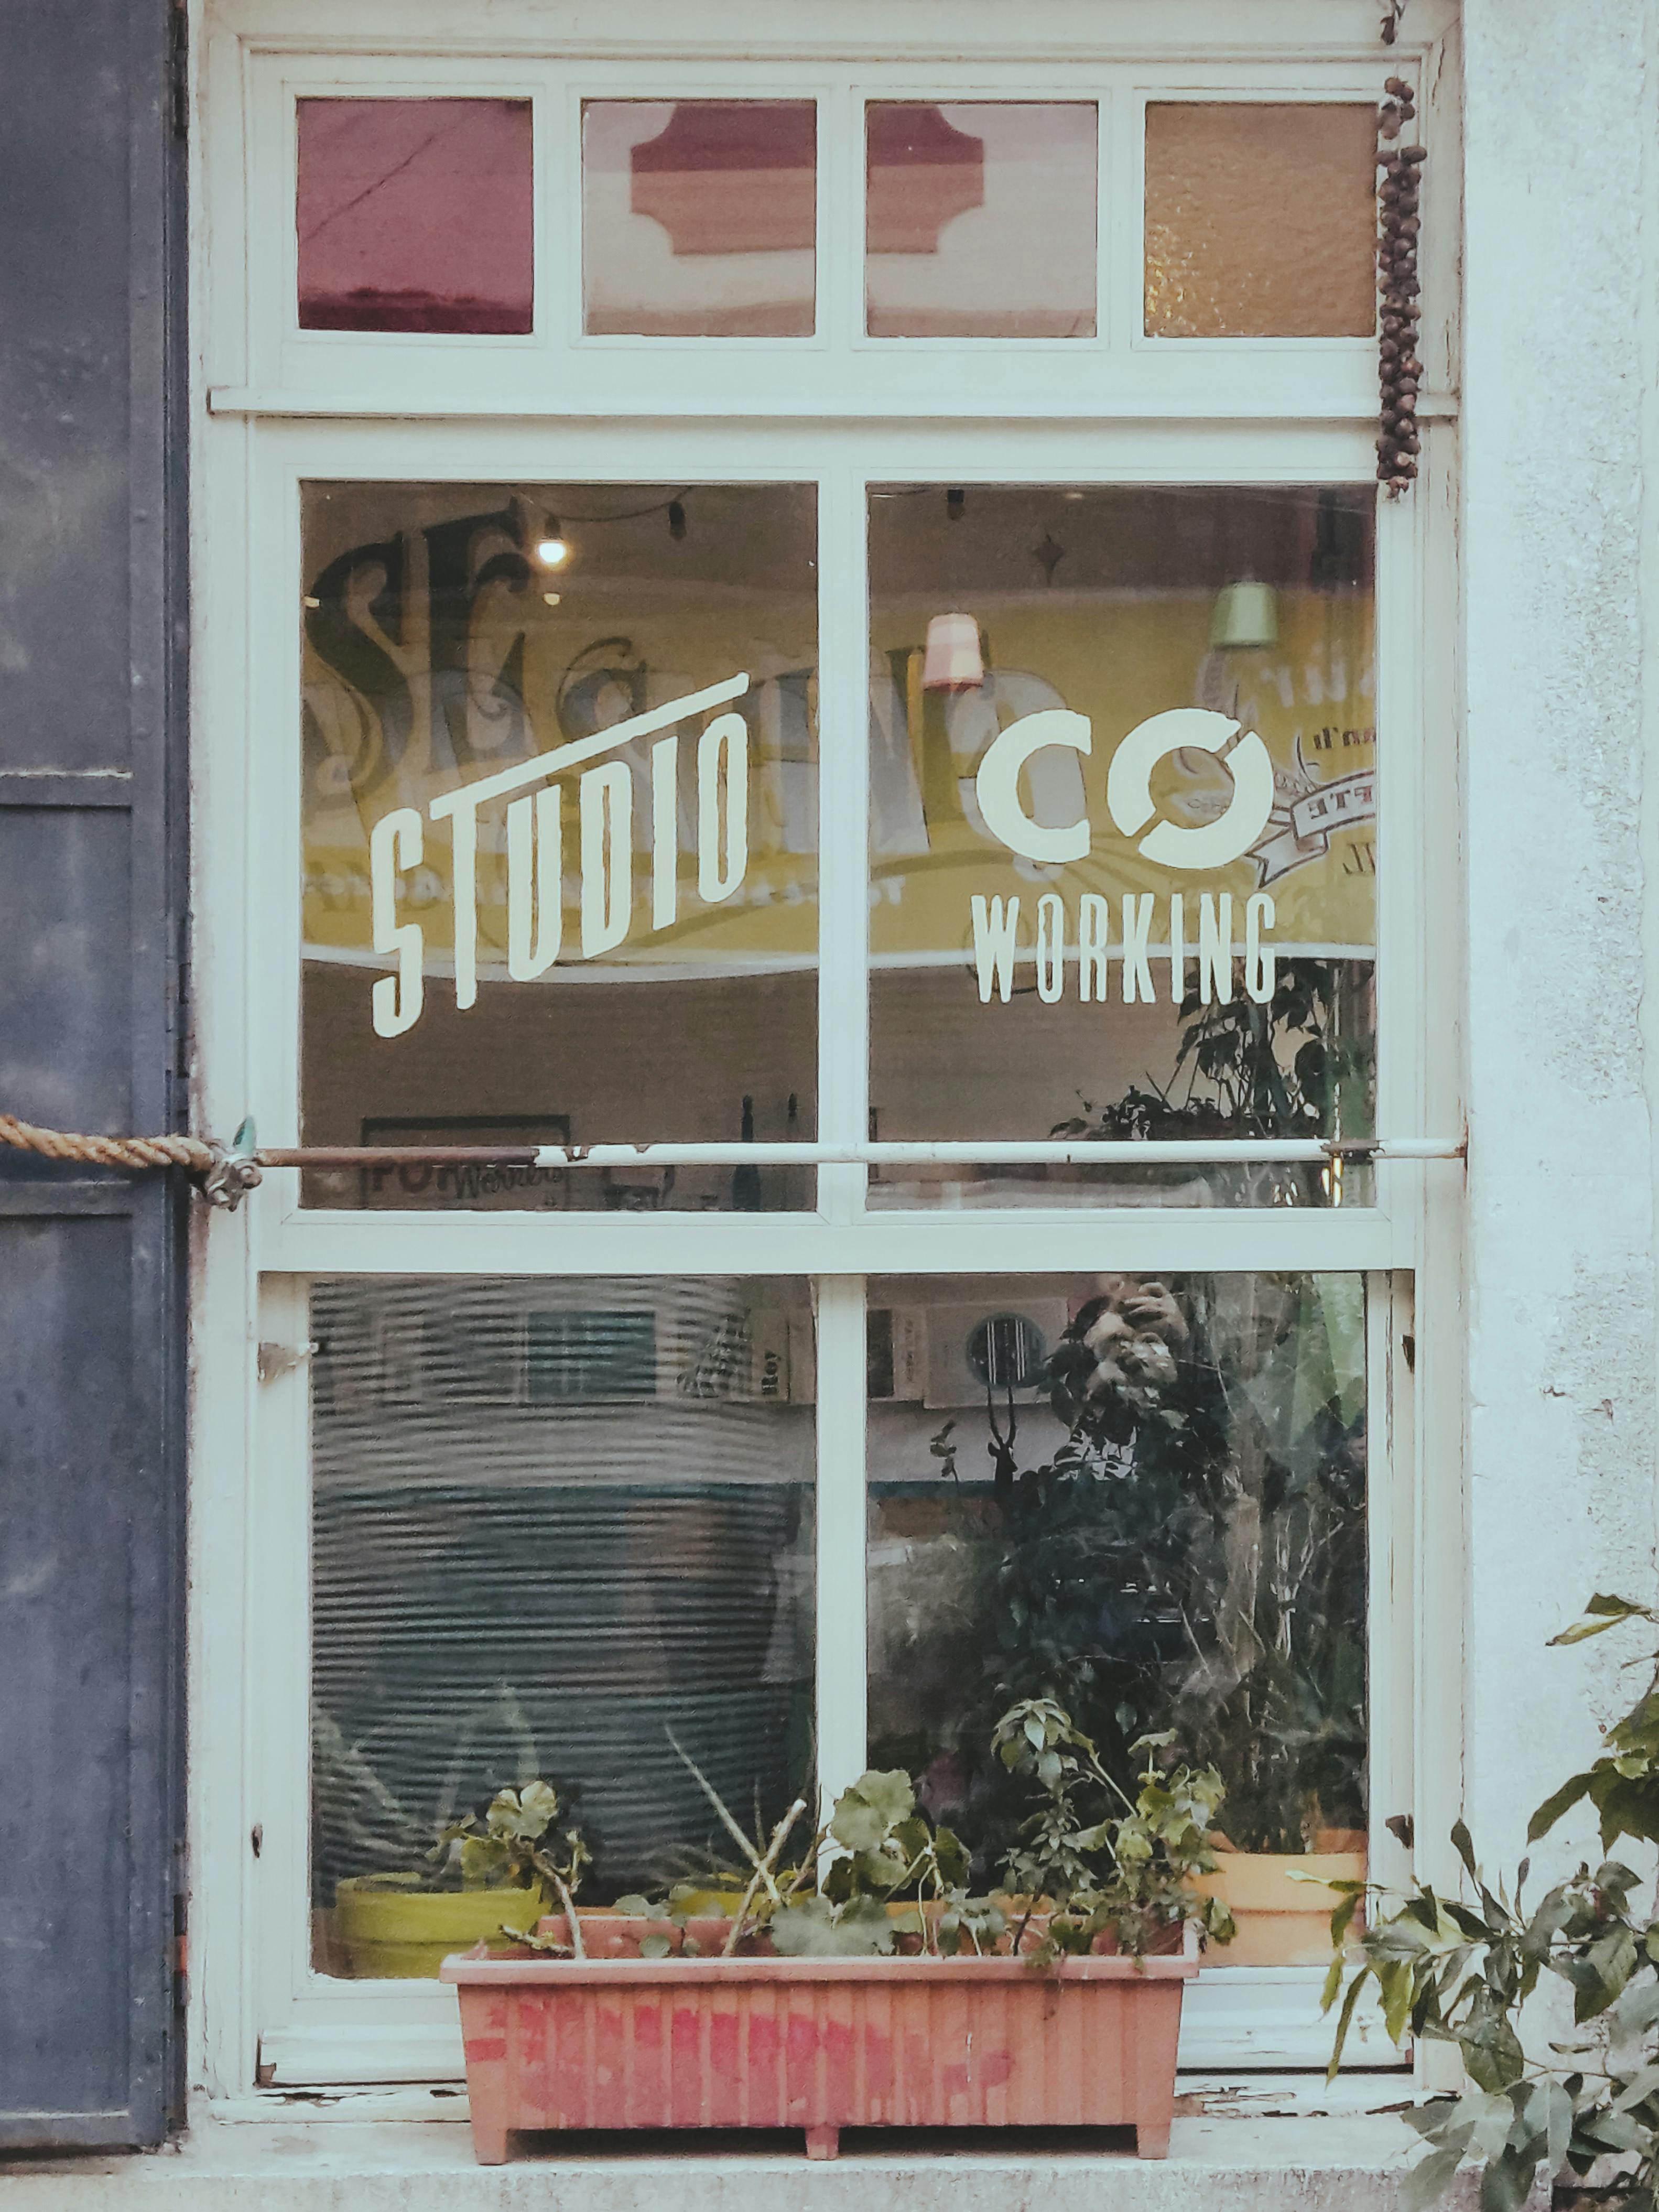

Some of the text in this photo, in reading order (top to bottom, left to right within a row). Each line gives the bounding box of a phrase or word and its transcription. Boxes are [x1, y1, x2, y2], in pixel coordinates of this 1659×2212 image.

[370, 671, 750, 1038] STUDIO
[975, 708, 1275, 870] CO
[971, 892, 1276, 1005] WORKING
